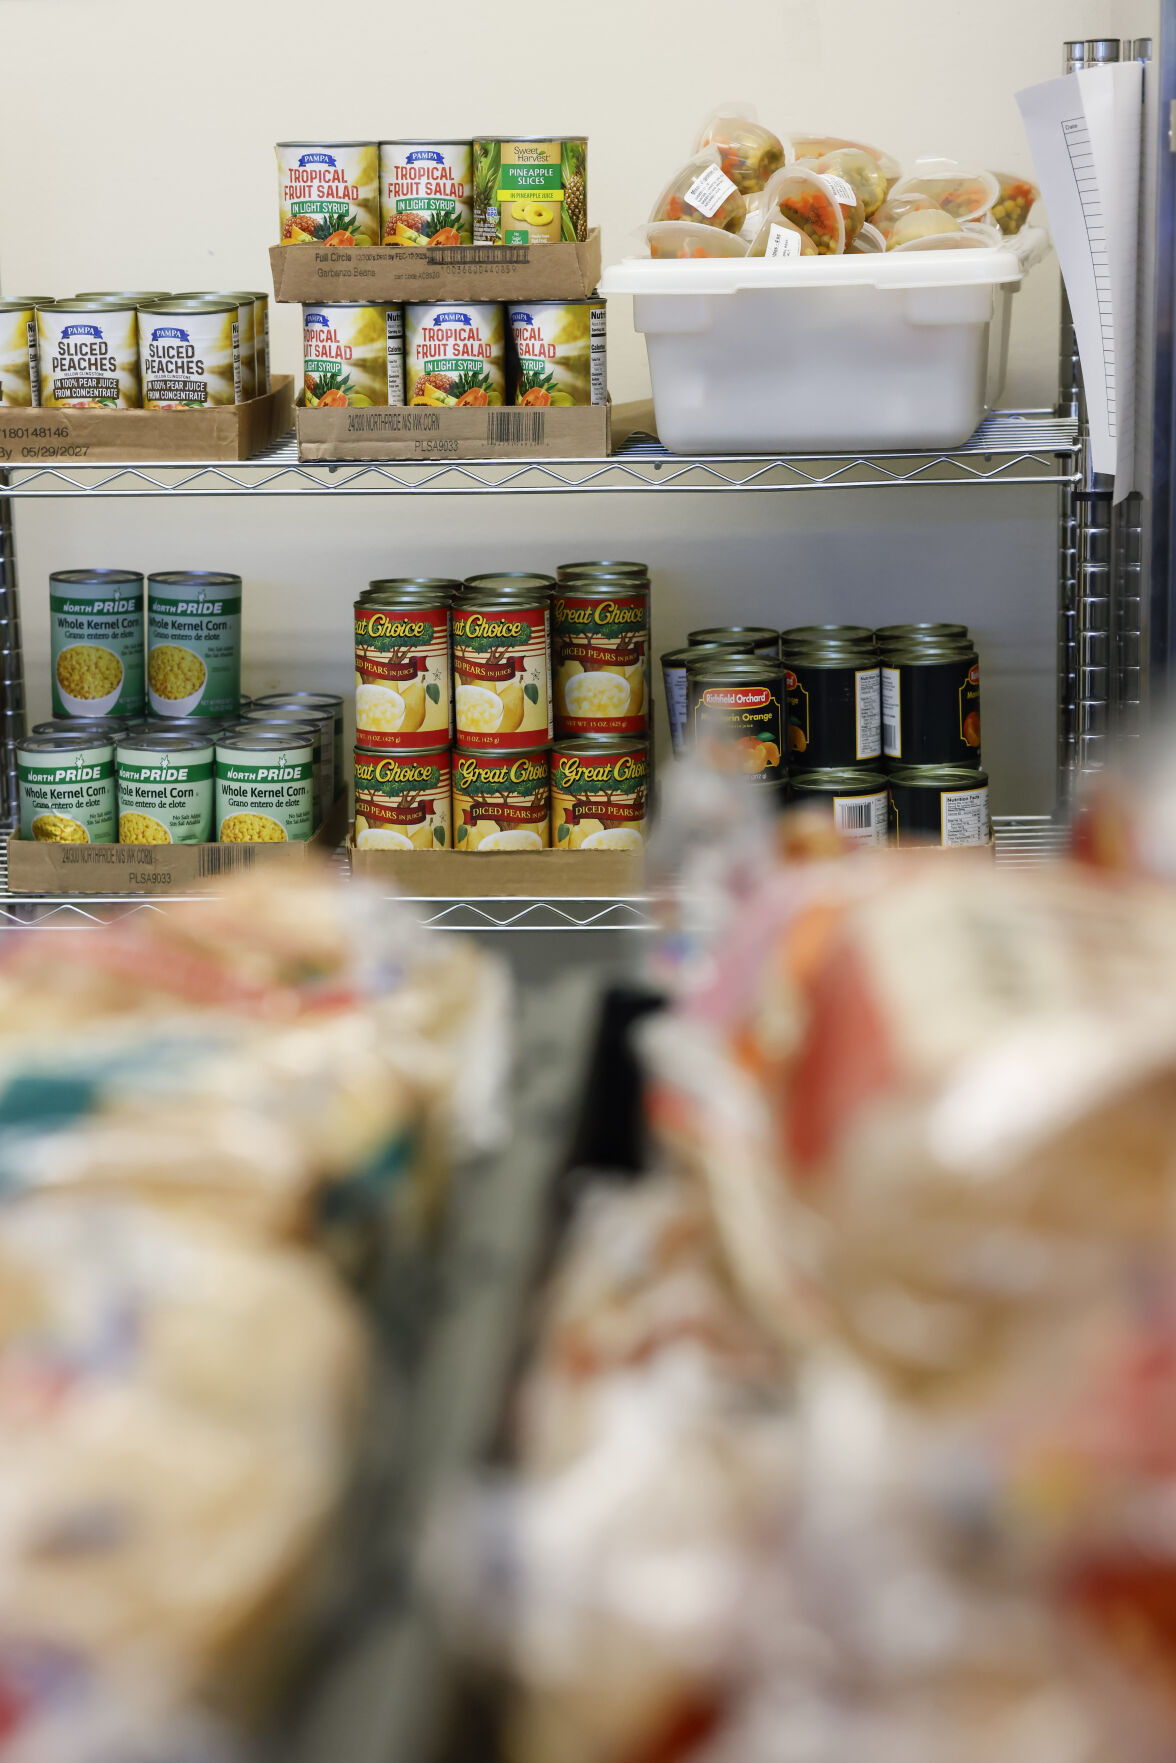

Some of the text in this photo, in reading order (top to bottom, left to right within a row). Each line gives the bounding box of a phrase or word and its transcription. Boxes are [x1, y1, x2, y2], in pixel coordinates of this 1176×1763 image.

[1065, 122, 1078, 130] Date
[412, 152, 438, 160] PAMPA
[514, 146, 539, 156] Sweet
[304, 154, 330, 162] PAMPA
[518, 154, 548, 162] Harvest
[288, 168, 348, 184] TROPICAL
[394, 166, 454, 180] TROPICAL
[510, 168, 554, 177] PINEAPPLE
[518, 176, 544, 185] SLICES
[284, 185, 359, 201] FRUIT SALAD
[388, 182, 464, 199] FRUIT SALAD
[292, 202, 348, 214] IN LIGHT SYRUP
[398, 200, 454, 210] IN LIGHT SYRUP
[316, 253, 328, 262] Full
[330, 253, 352, 262] Circle
[318, 267, 376, 278] Garbanzo Beans
[440, 314, 464, 322] PAMPA
[68, 326, 94, 334] PAMPA
[156, 329, 181, 338] PAMPA
[422, 328, 482, 342] TROPICAL
[58, 341, 108, 356] SLICED
[148, 344, 195, 359] SLICED
[315, 345, 352, 360] SALAD
[416, 343, 492, 360] FRUIT SALAD
[520, 343, 556, 358] SALAD
[52, 356, 117, 374] PEACHES
[145, 358, 204, 376] PEACHES
[318, 362, 341, 372] SYRUP
[426, 361, 482, 371] IN LIGHT SYRUP
[522, 360, 544, 370] SYRUP
[54, 378, 117, 388] IN 100% PEAR JUICE
[166, 382, 184, 390] PEAR
[185, 382, 204, 390] JUICE
[56, 388, 118, 398] FROM CONCENTRATE
[148, 391, 205, 400] FROM CONCENTRATE
[424, 414, 440, 431] CORN
[2, 428, 69, 439] 180148146
[22, 446, 90, 458] 05/29/2027
[414, 440, 459, 452] PLSA9033
[64, 600, 136, 613] NORTH PRIDE
[152, 601, 223, 614] NORTH PRIDE
[555, 600, 643, 624] Great Choice
[58, 617, 140, 630] Whole Kernel Corn
[172, 620, 227, 631] Kernel Corn
[368, 614, 424, 638] Choice
[466, 614, 522, 638] Choice
[64, 630, 134, 640] Grano entero de elote
[170, 632, 193, 640] entero
[194, 632, 203, 640] de
[204, 632, 220, 640] elote
[562, 647, 586, 656] DICED
[588, 649, 616, 660] PEARS
[364, 662, 388, 674] PEARS
[398, 668, 414, 677] JUICE
[462, 663, 486, 676] PEARS
[495, 668, 512, 677] JUICE
[736, 692, 766, 704] Orchard
[742, 713, 772, 722] Orange
[28, 766, 101, 782] NORTH PRIDE
[120, 766, 188, 780] NORTH PRIDE
[227, 766, 302, 780] NORTH PRIDE
[375, 758, 432, 782] Choice
[458, 758, 508, 788] Great
[560, 758, 612, 788] Great
[25, 786, 106, 800] Whole Kernel Corn
[135, 786, 194, 798] Kernel Corn
[222, 784, 306, 798] Whole Kernel Corn
[32, 799, 100, 810] Grano entero de elote
[134, 800, 156, 808] entero
[158, 800, 167, 808] de
[168, 800, 186, 808] elote
[228, 798, 300, 808] Grano entero de elote
[371, 807, 397, 820] PEARS
[406, 812, 422, 820] JUICE
[472, 807, 502, 816] DICED
[504, 808, 531, 818] PEARS
[576, 806, 606, 815] DICED
[608, 806, 634, 816] PEARS
[136, 848, 152, 864] CORN
[129, 872, 172, 884] PLSA9033
